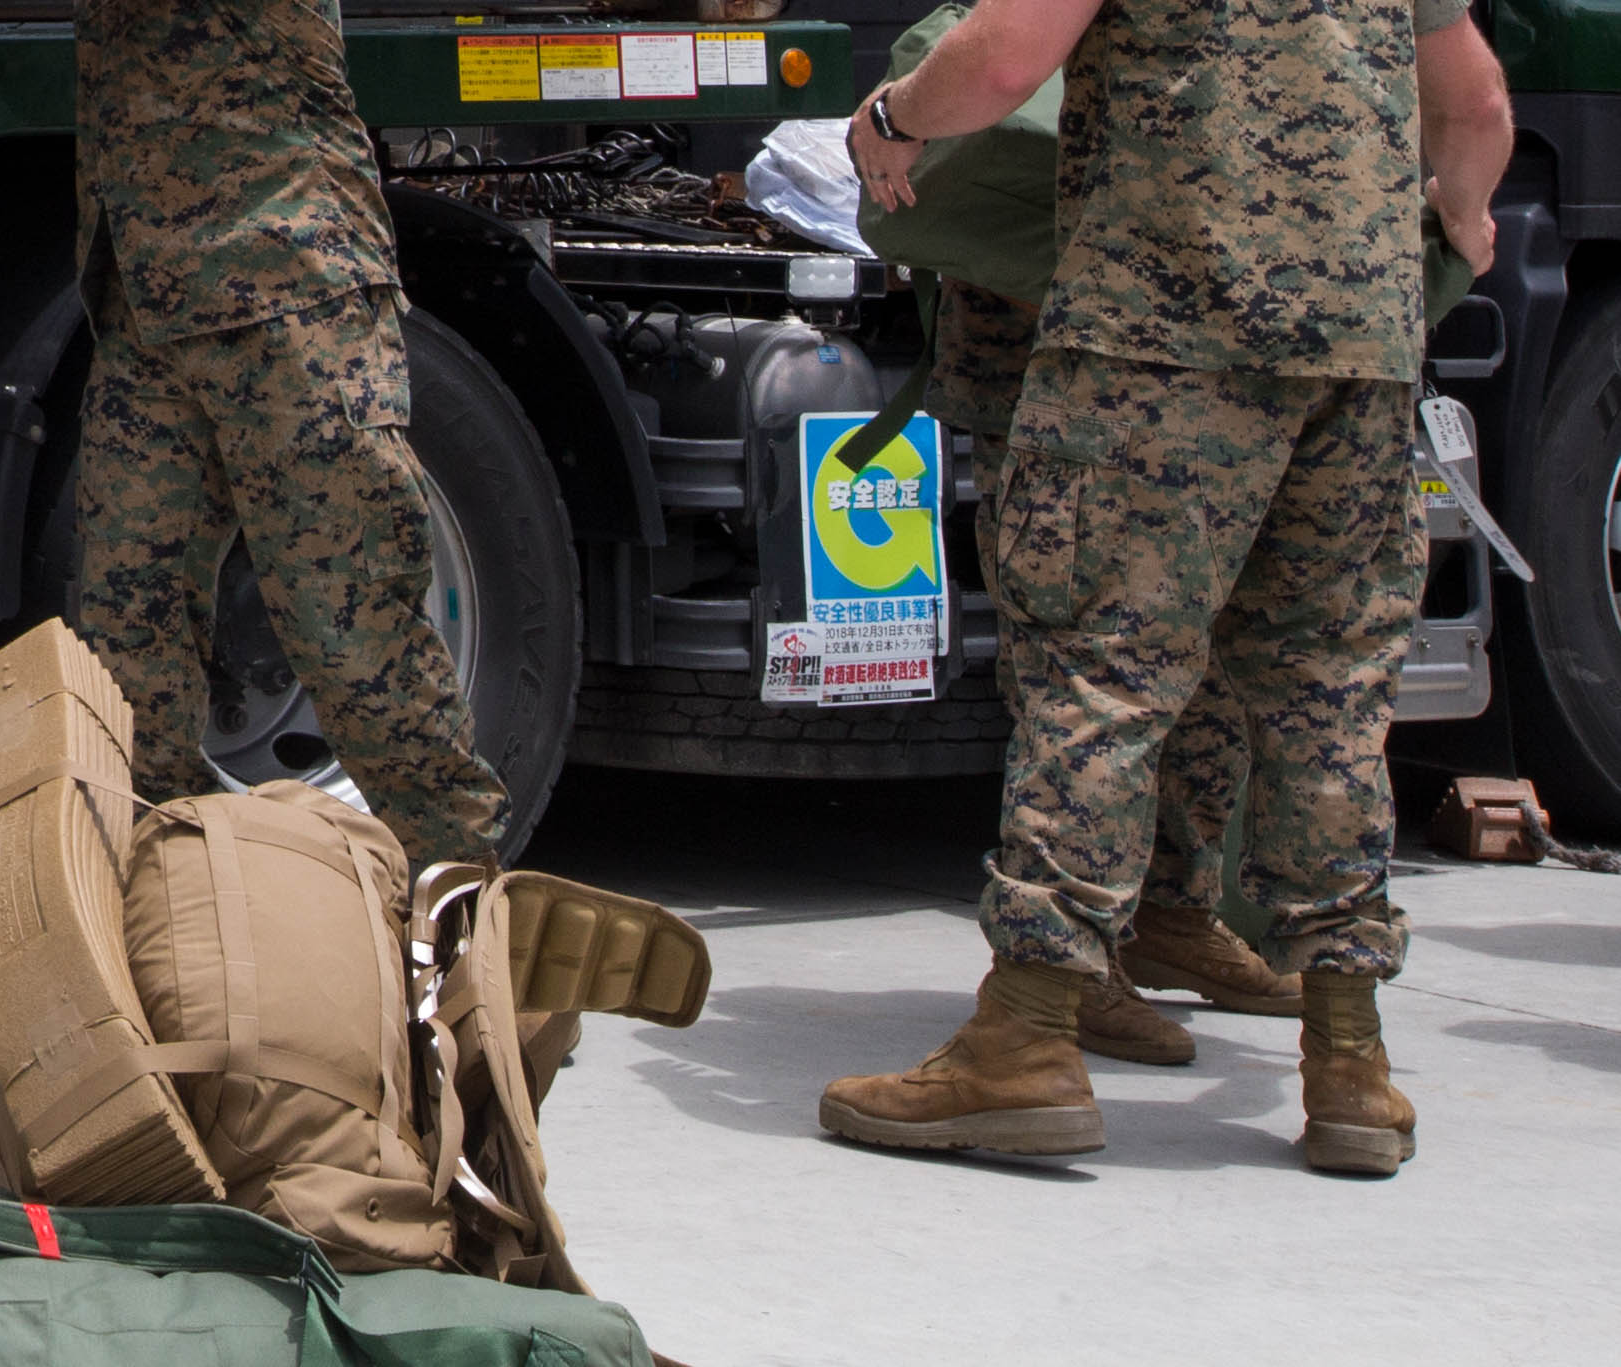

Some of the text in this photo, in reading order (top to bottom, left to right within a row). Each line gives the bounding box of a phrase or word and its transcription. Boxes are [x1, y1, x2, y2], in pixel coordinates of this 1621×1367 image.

[826, 477, 921, 512] 安全認定
[812, 598, 945, 625] 安全性優良事業所
